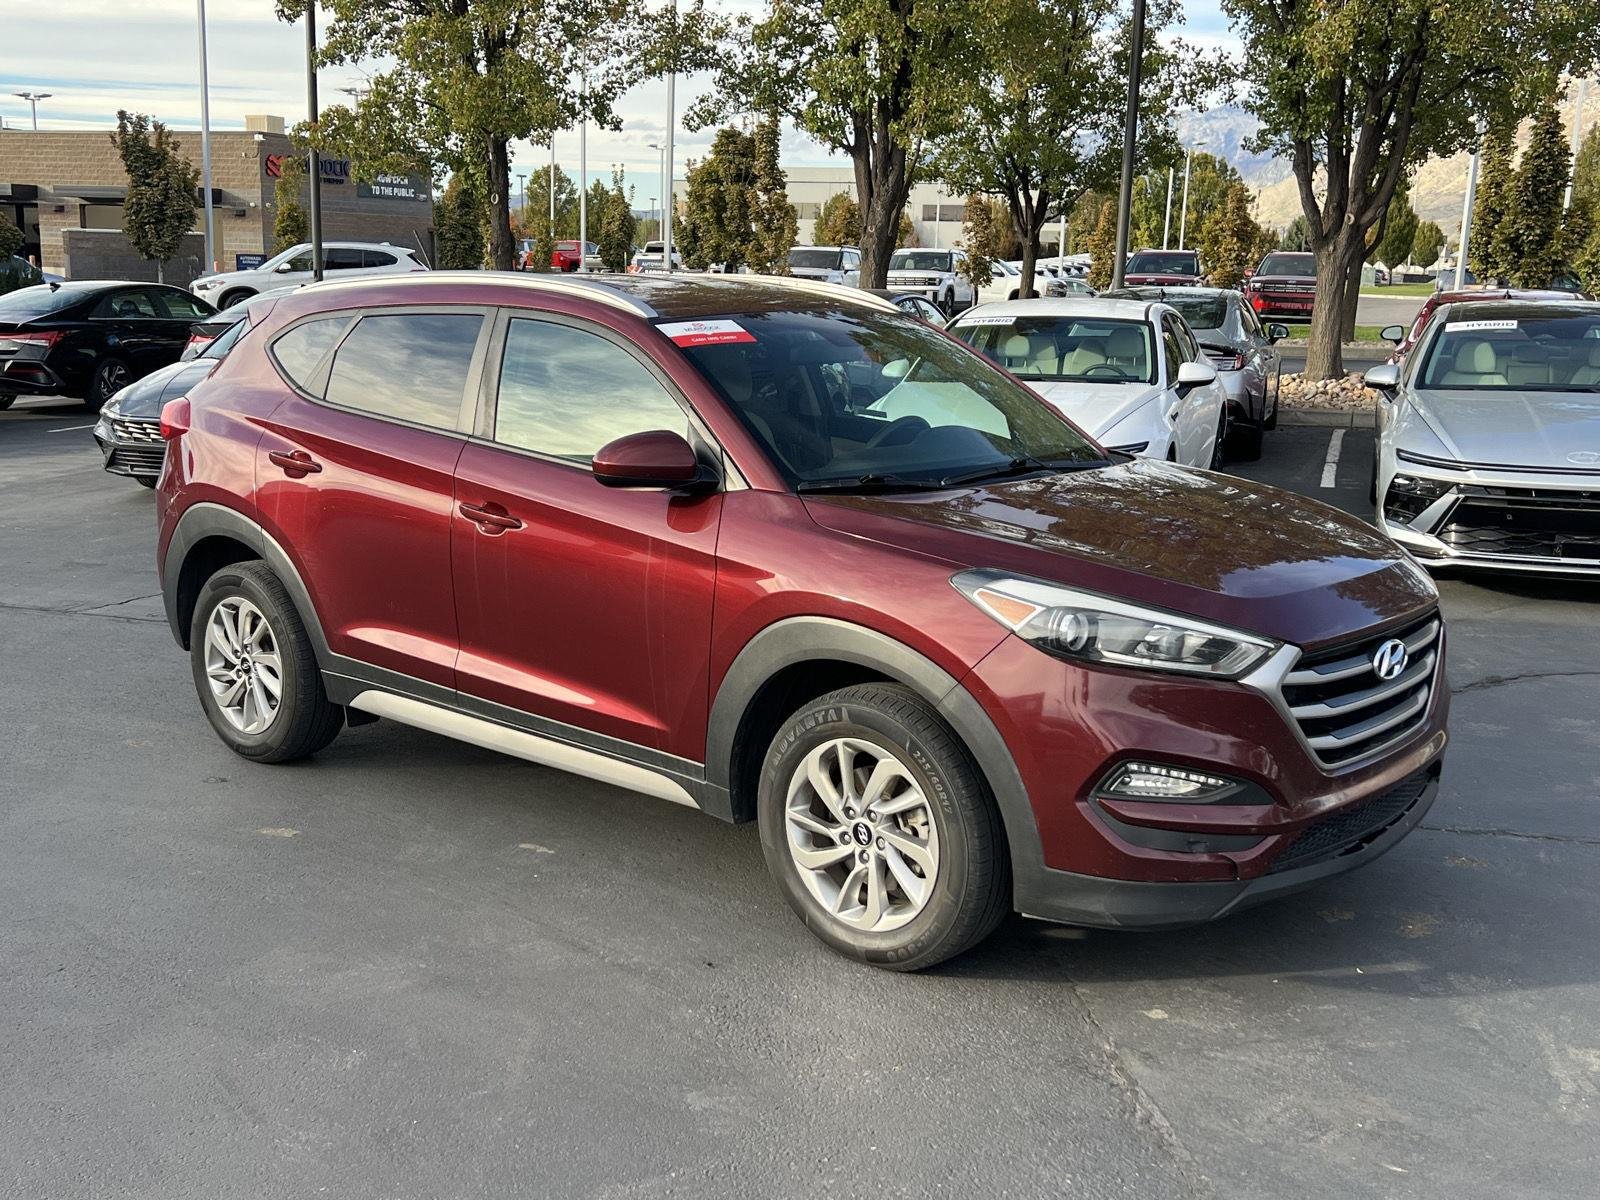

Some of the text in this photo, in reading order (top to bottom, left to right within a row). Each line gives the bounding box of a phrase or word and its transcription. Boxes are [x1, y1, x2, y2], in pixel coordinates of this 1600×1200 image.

[371, 185, 380, 195] TO
[381, 186, 393, 196] THE
[393, 187, 415, 198] PUBLIC
